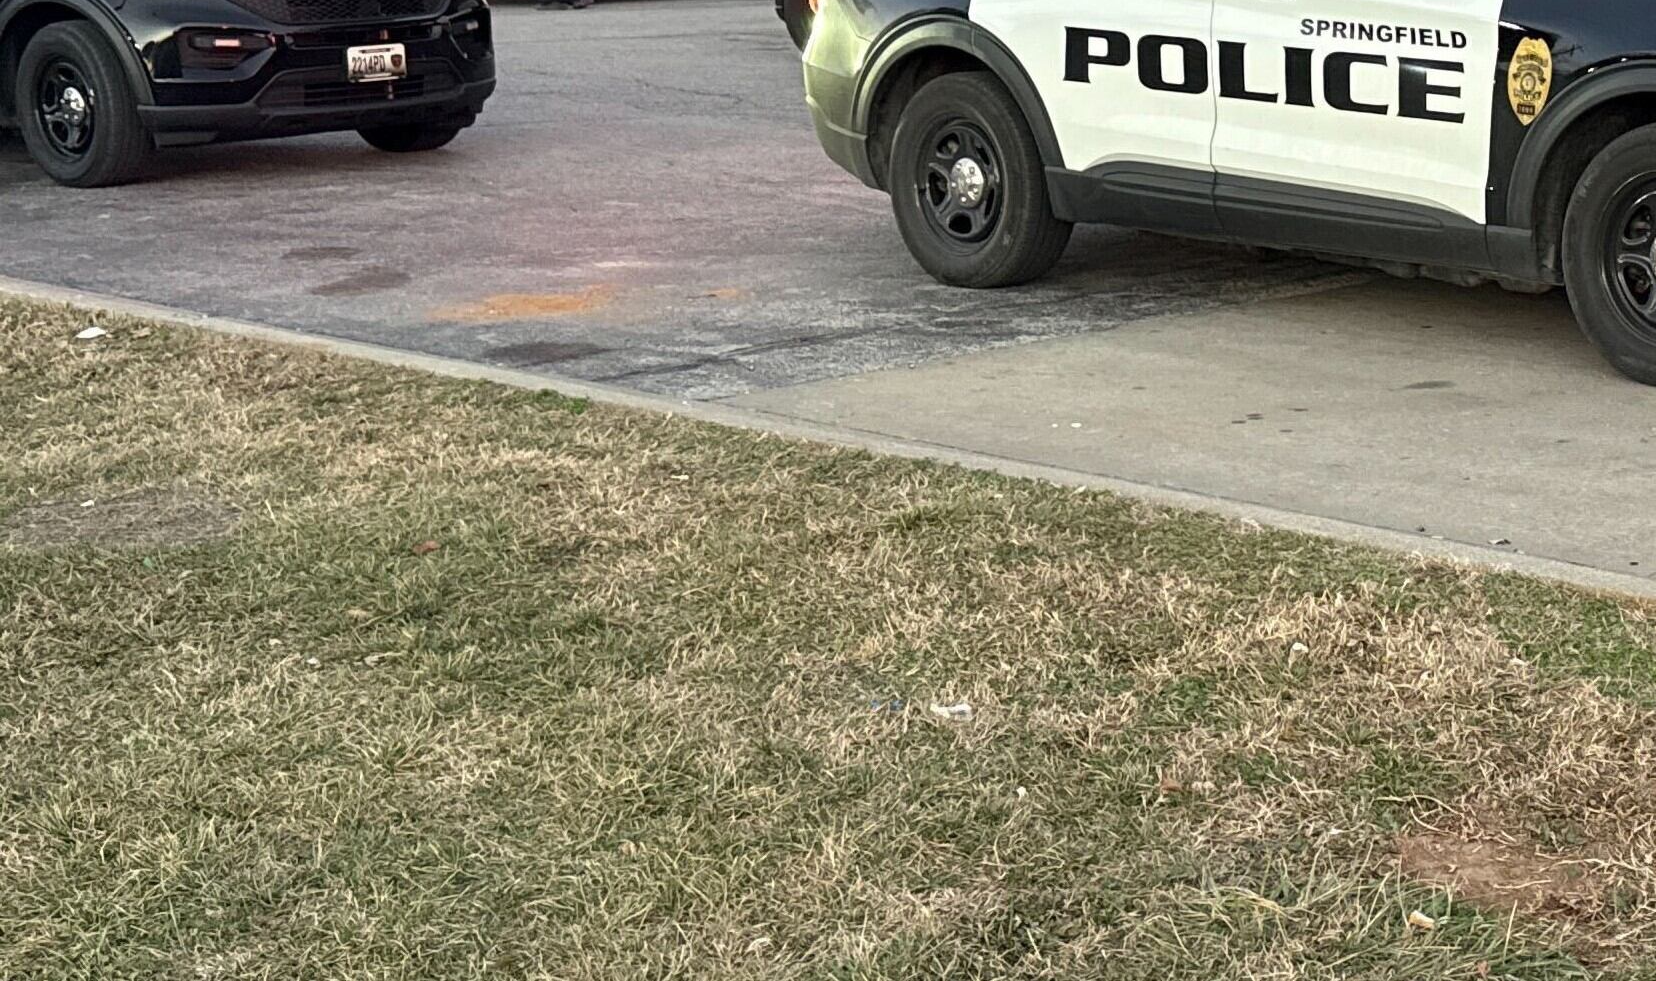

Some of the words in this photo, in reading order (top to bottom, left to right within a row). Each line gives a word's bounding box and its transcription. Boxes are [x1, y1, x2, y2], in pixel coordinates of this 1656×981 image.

[1299, 18, 1468, 49] SPRINGFIELD
[351, 55, 386, 75] 2214PD
[1062, 25, 1466, 124] POLICE
